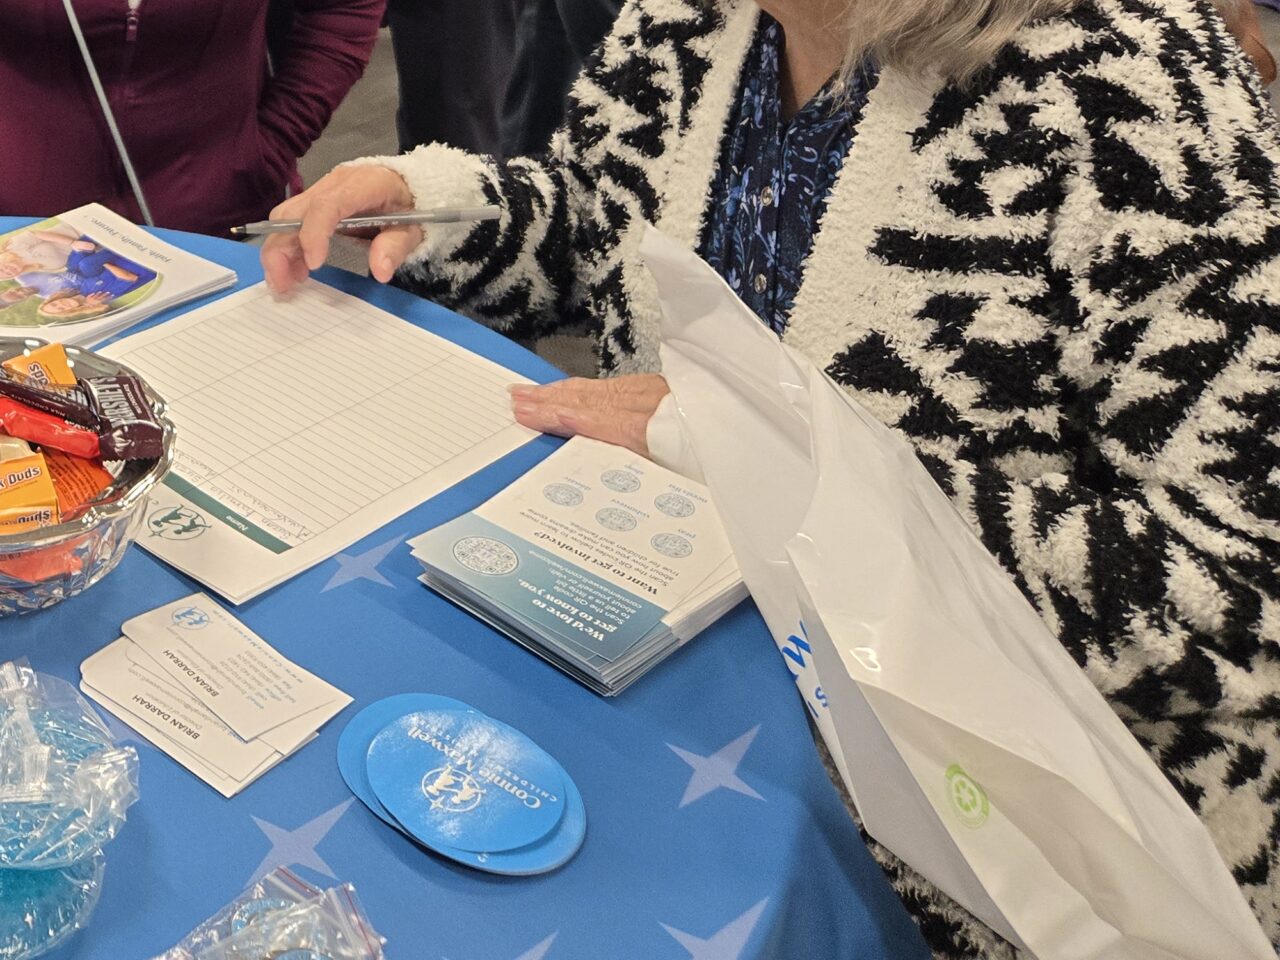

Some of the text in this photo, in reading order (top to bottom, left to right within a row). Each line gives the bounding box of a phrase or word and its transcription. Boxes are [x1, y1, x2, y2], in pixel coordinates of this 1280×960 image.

[9, 466, 41, 484] Duds
[225, 514, 248, 531] Name
[569, 535, 593, 549] below
[614, 550, 630, 558] you
[615, 544, 647, 561] children
[533, 530, 656, 594] Want to get involved?
[630, 558, 648, 568] how
[633, 567, 647, 575] the
[649, 567, 674, 580] about
[555, 579, 567, 587] bit
[648, 574, 668, 586] Scan
[568, 585, 587, 597] little
[577, 583, 612, 600] yourself
[518, 577, 617, 632] get to know you.
[552, 585, 624, 624] Scan the QR code
[604, 604, 619, 613] tell
[611, 599, 636, 613] about
[531, 598, 603, 640] We'd love to
[161, 648, 220, 698] BRIAN DARRAH
[131, 694, 200, 739] BRIAN DARRAH
[408, 726, 542, 809] Connie Maxwell
